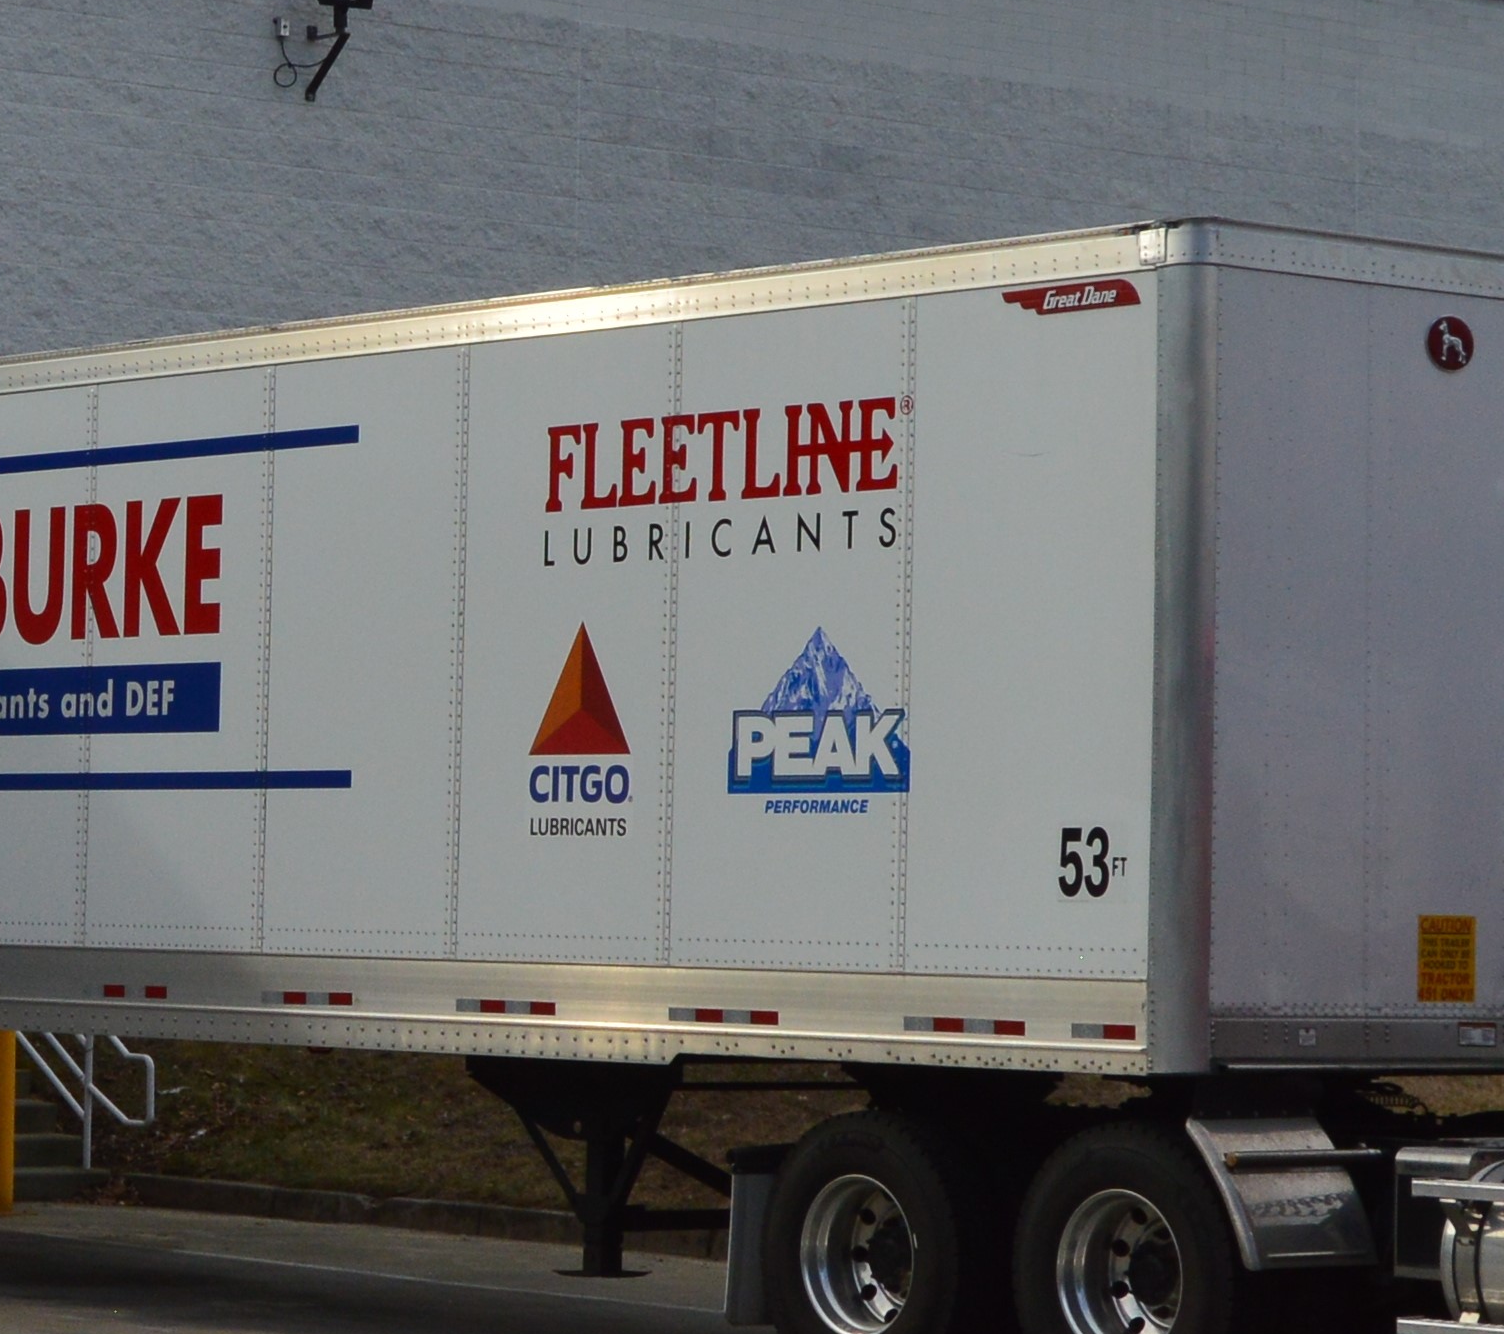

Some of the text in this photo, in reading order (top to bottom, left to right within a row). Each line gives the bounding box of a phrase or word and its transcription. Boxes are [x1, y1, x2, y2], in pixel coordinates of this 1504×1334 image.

[1043, 285, 1117, 310] Great Dane
[544, 507, 897, 567] LUBRICANTS
[60, 678, 114, 720] and
[125, 680, 175, 717] DEF
[735, 712, 905, 779] PEAK
[529, 764, 630, 804] CITGO
[764, 799, 869, 814] PERFORMANCE
[530, 817, 627, 837] LUBRICANTS
[1058, 826, 1128, 898] 53 FT
[1421, 918, 1472, 933] CAUTION
